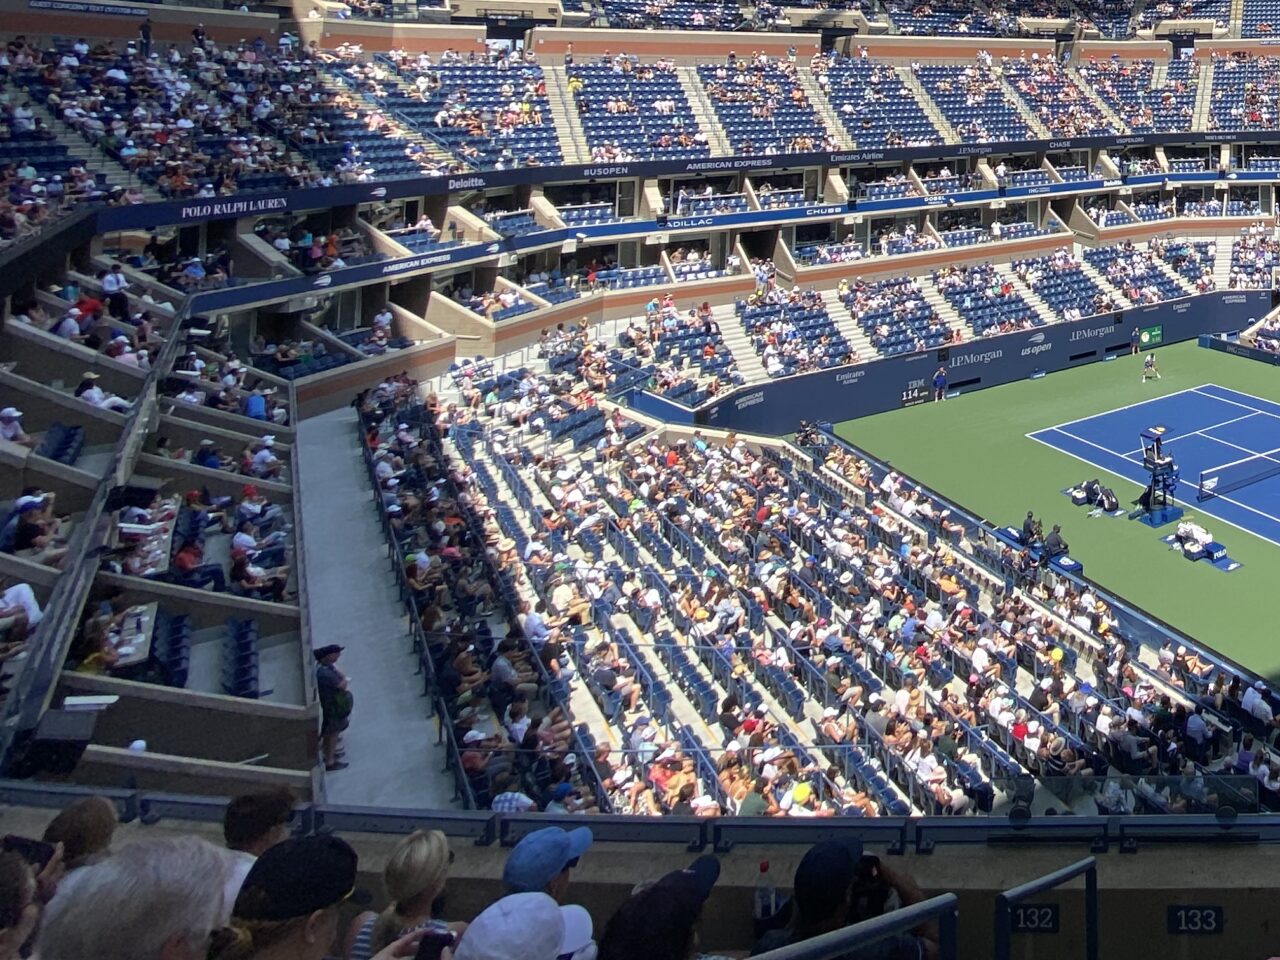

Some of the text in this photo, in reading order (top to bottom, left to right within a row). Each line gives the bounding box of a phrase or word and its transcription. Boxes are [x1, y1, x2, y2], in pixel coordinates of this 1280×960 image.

[957, 146, 992, 154] J.P.Morgan
[1049, 140, 1071, 149] CHASE
[830, 152, 884, 162] Emirates Airline
[686, 158, 772, 171] AMERICAN EXPRESS
[583, 166, 629, 177] #USOPEN
[448, 177, 486, 190] Deloitte.
[182, 198, 287, 218] POLO RALPH LAUREN
[806, 207, 842, 216] CHUBB
[382, 254, 451, 273] AMERICAN EXPRESS
[1069, 325, 1115, 342] J.P.Morgan
[1021, 342, 1052, 356] us open
[948, 349, 1003, 368] J.P.Morgan
[835, 370, 865, 382] Emirates
[907, 378, 925, 390] IBM
[734, 391, 764, 410] AMERICAN EXPRESS
[902, 388, 919, 401] 114
[1213, 548, 1227, 560] POLO
[1016, 907, 1053, 929] 132
[1177, 909, 1217, 930] 133
